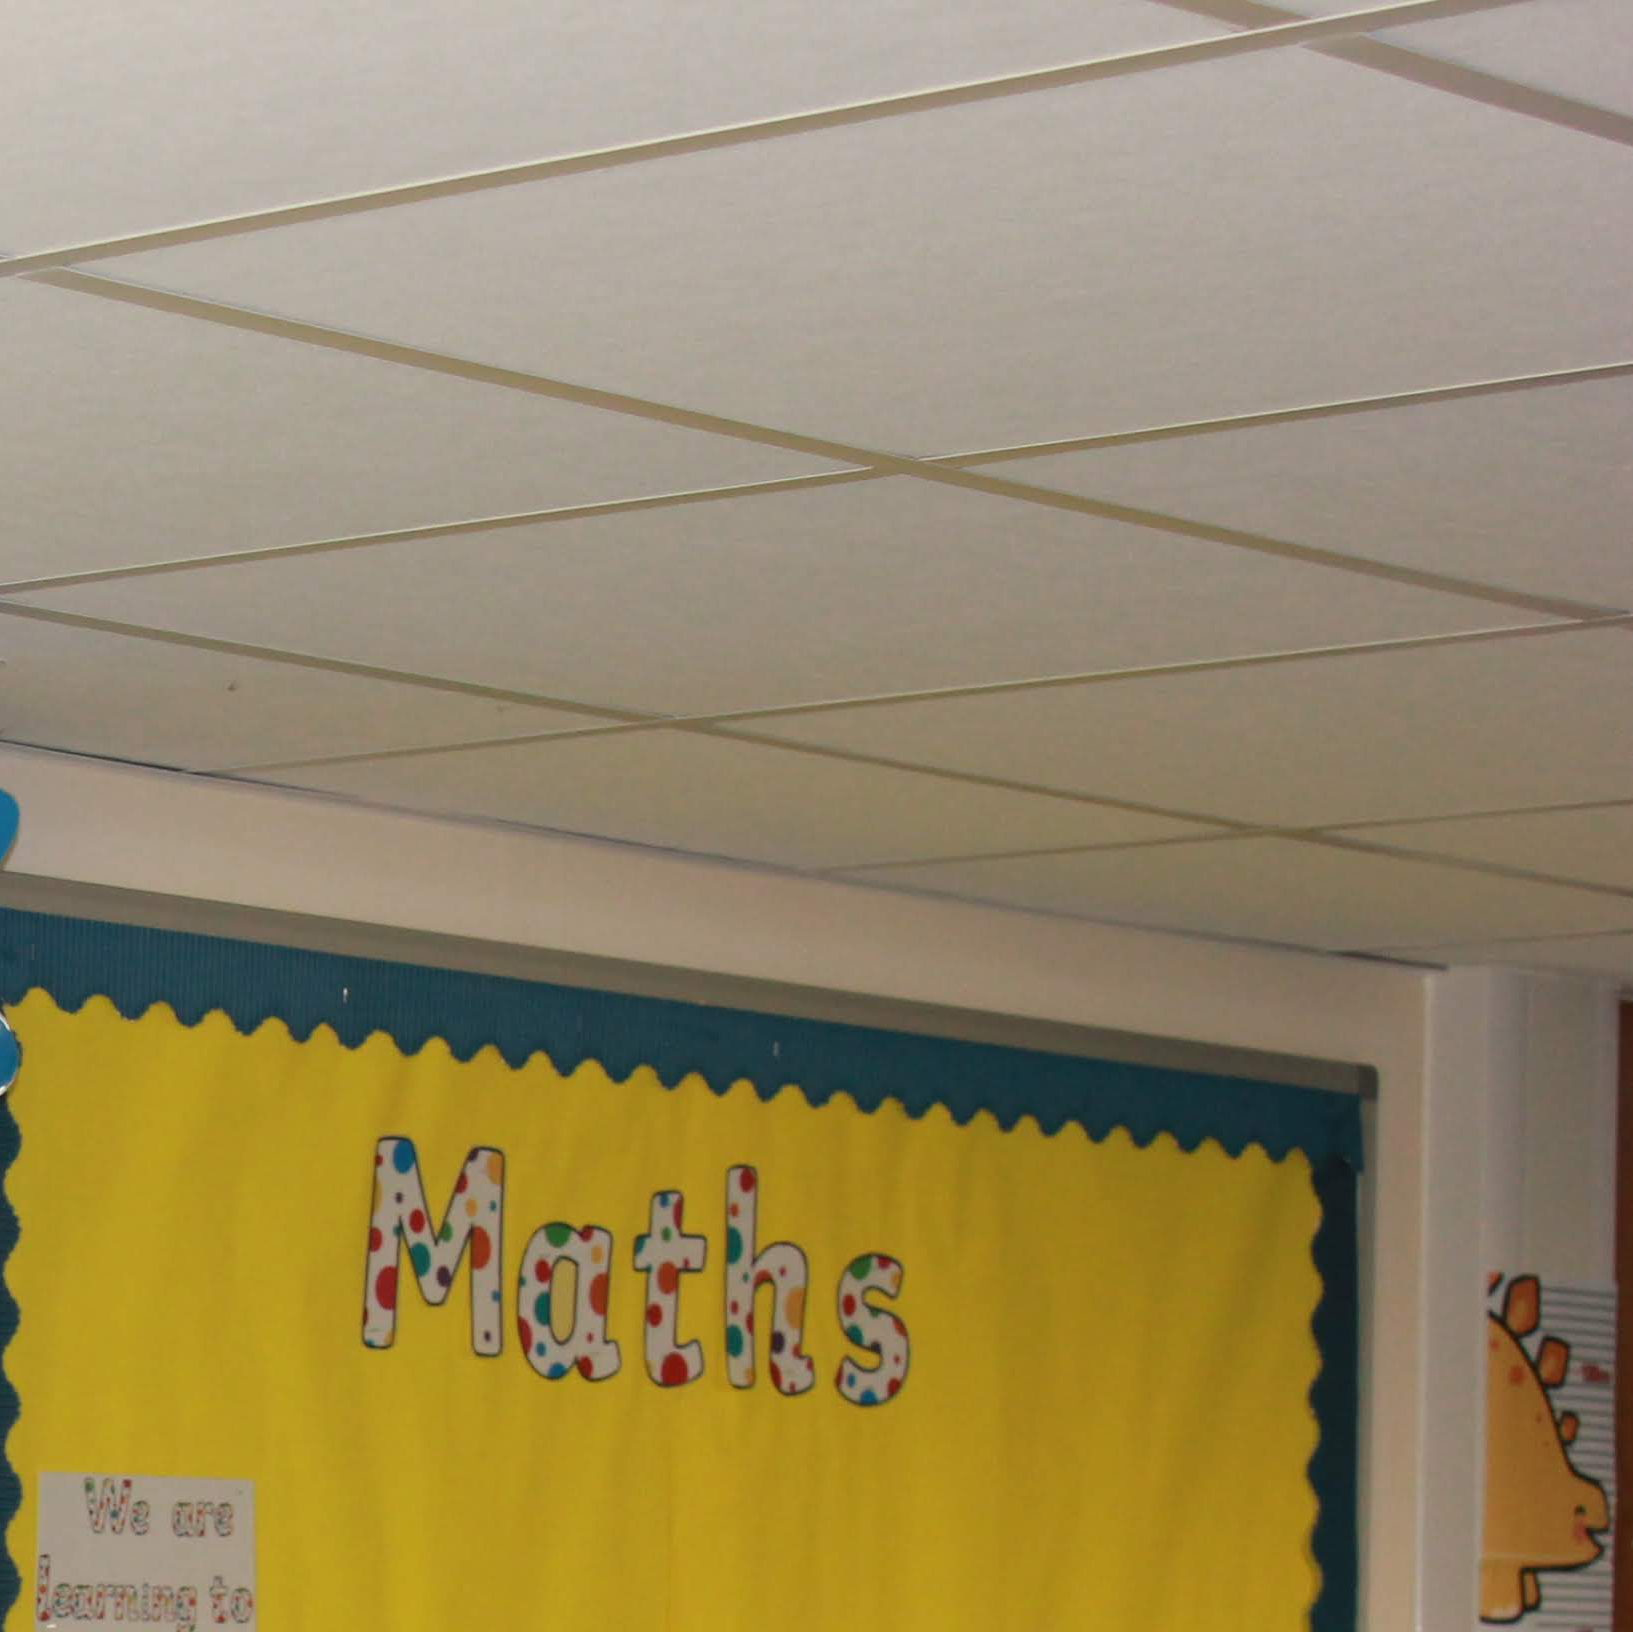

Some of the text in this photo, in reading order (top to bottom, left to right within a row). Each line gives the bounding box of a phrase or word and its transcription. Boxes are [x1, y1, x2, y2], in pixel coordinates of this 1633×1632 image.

[362, 1136, 909, 1407] Maths
[84, 1477, 233, 1537] We are
[209, 1575, 254, 1624] to
